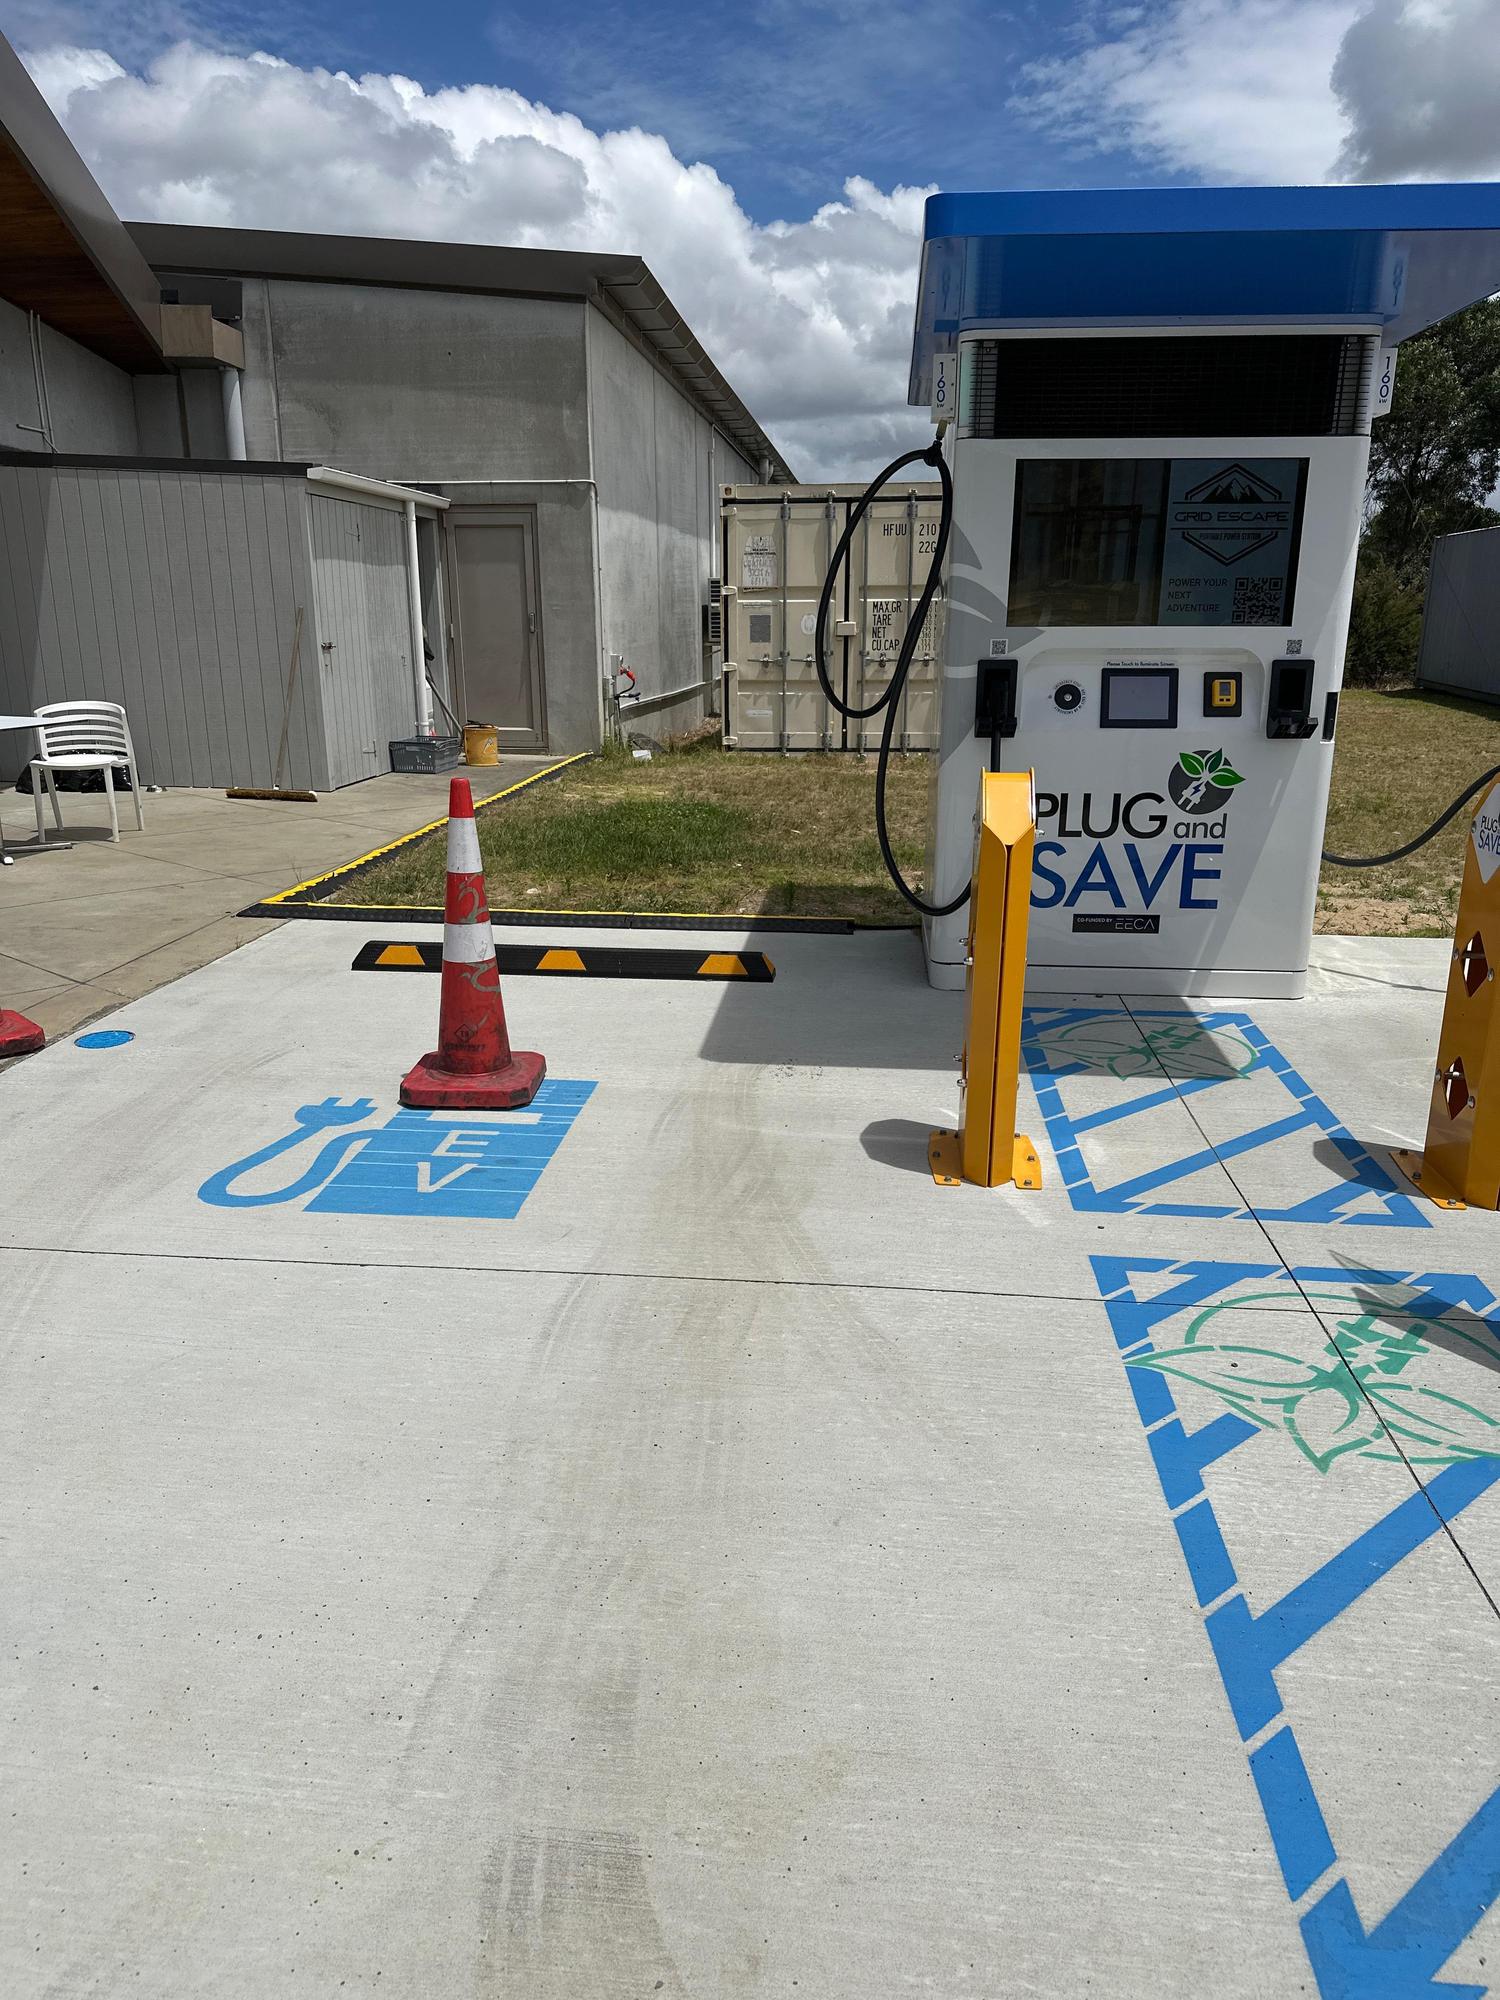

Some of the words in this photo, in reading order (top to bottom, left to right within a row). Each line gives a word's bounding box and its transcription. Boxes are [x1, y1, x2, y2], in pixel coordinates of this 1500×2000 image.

[936, 361, 945, 402] 160
[1380, 356, 1391, 398] 160
[1174, 511, 1212, 522] GRID
[1217, 511, 1290, 522] ESCAPE
[883, 523, 907, 537] HFUU
[919, 523, 941, 537] 210
[1168, 578, 1201, 588] POWER
[1203, 578, 1228, 588] YOUR
[1167, 591, 1192, 600] NEXT
[1166, 604, 1221, 613] ADVENTURE
[872, 613, 892, 626] TARE
[871, 626, 887, 639] NET
[1035, 792, 1168, 839] PLUG
[1173, 813, 1228, 839] and
[1481, 815, 1498, 833] PLUG
[1029, 841, 1224, 910] SAVE
[1115, 918, 1155, 930] EECA
